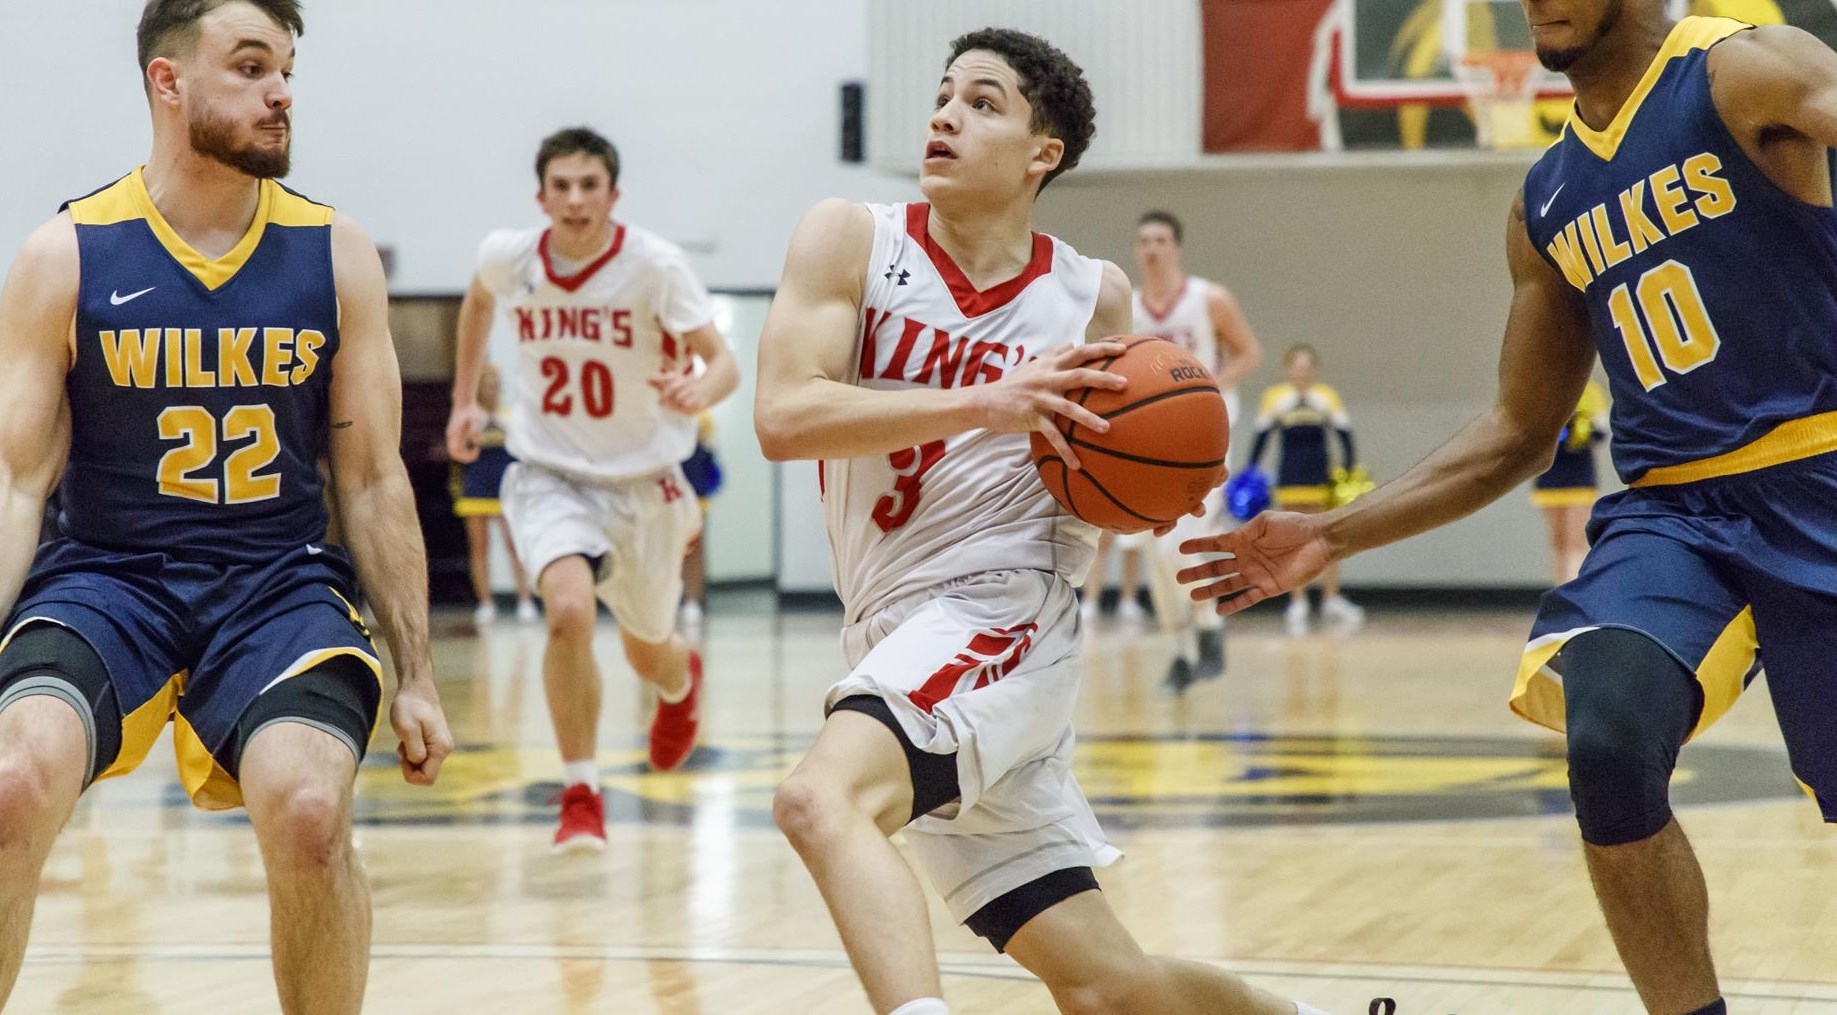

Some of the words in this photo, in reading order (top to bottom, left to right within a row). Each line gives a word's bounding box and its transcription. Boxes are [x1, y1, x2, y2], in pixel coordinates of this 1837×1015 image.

[1546, 152, 1737, 294] WILKES
[98, 326, 327, 389] WILKES
[514, 305, 633, 349] KING'S
[858, 306, 1037, 390] KING'
[1608, 258, 1721, 393] 10
[540, 354, 615, 420] 20
[156, 403, 282, 504] 22
